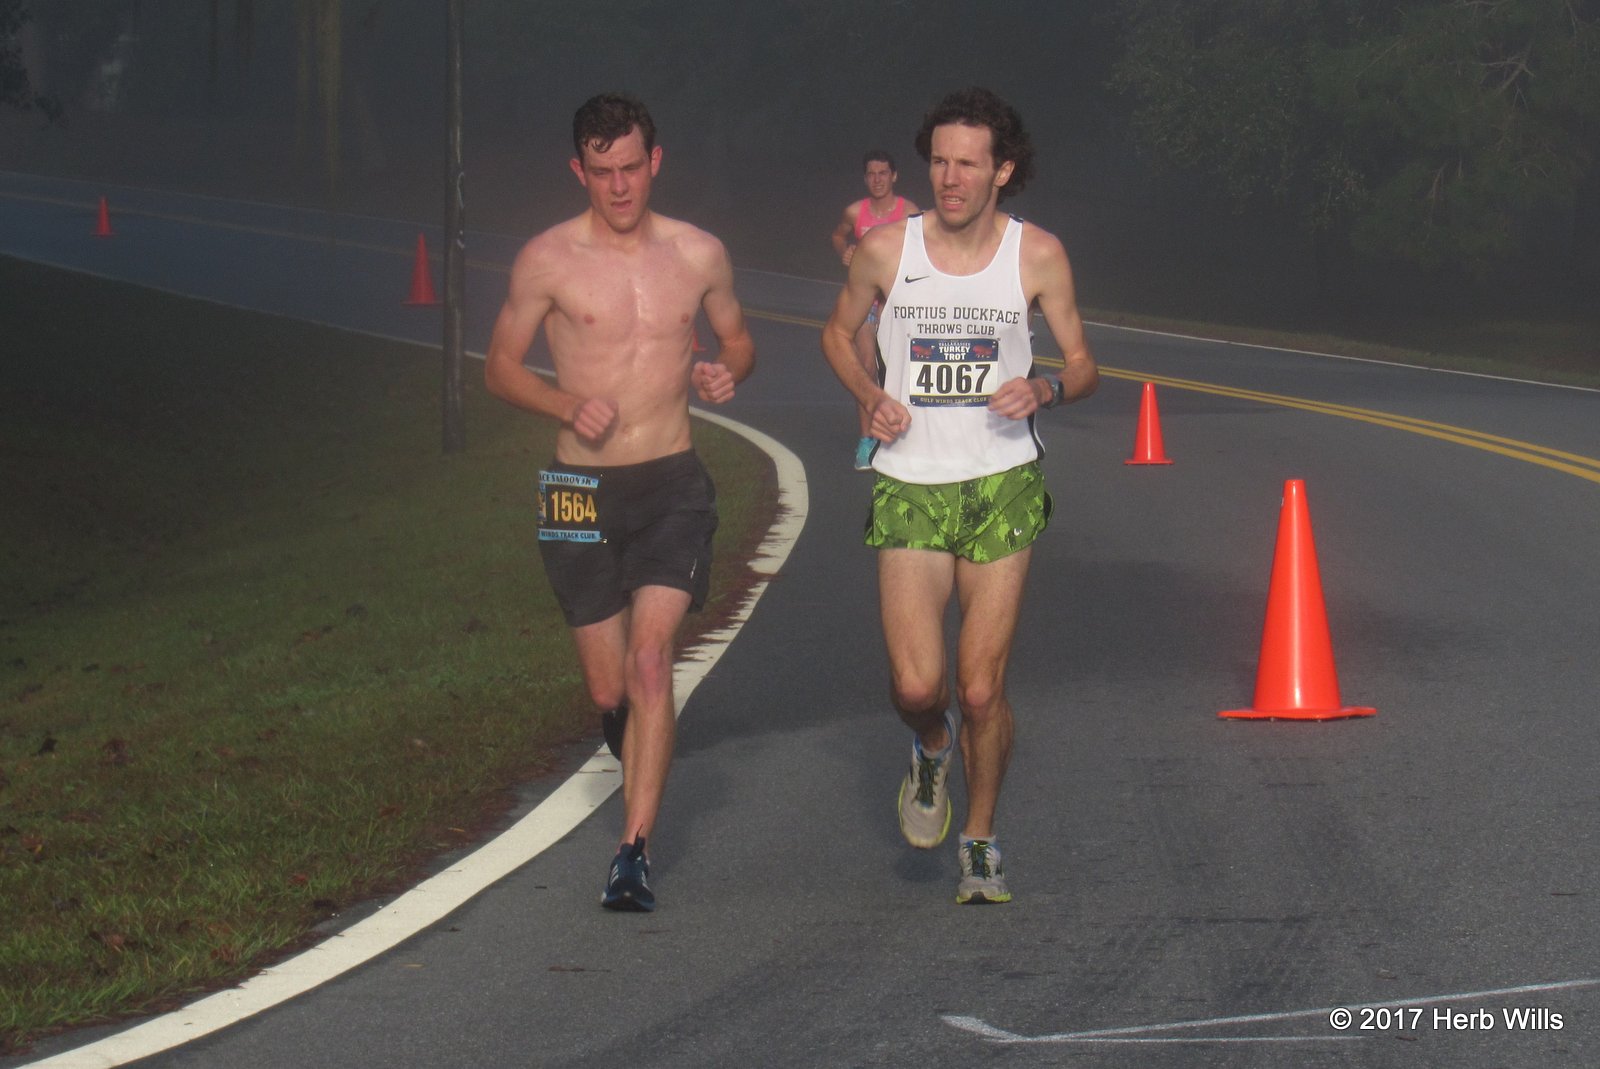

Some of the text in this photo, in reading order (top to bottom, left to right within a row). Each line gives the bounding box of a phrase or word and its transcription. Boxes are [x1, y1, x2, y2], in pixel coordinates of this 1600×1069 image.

[893, 306, 1020, 324] FORTIUS DUCKFACE
[917, 323, 995, 336] THROWS CLUB
[944, 353, 966, 361] TROT
[916, 364, 991, 394] 4067
[551, 491, 597, 523] 1564
